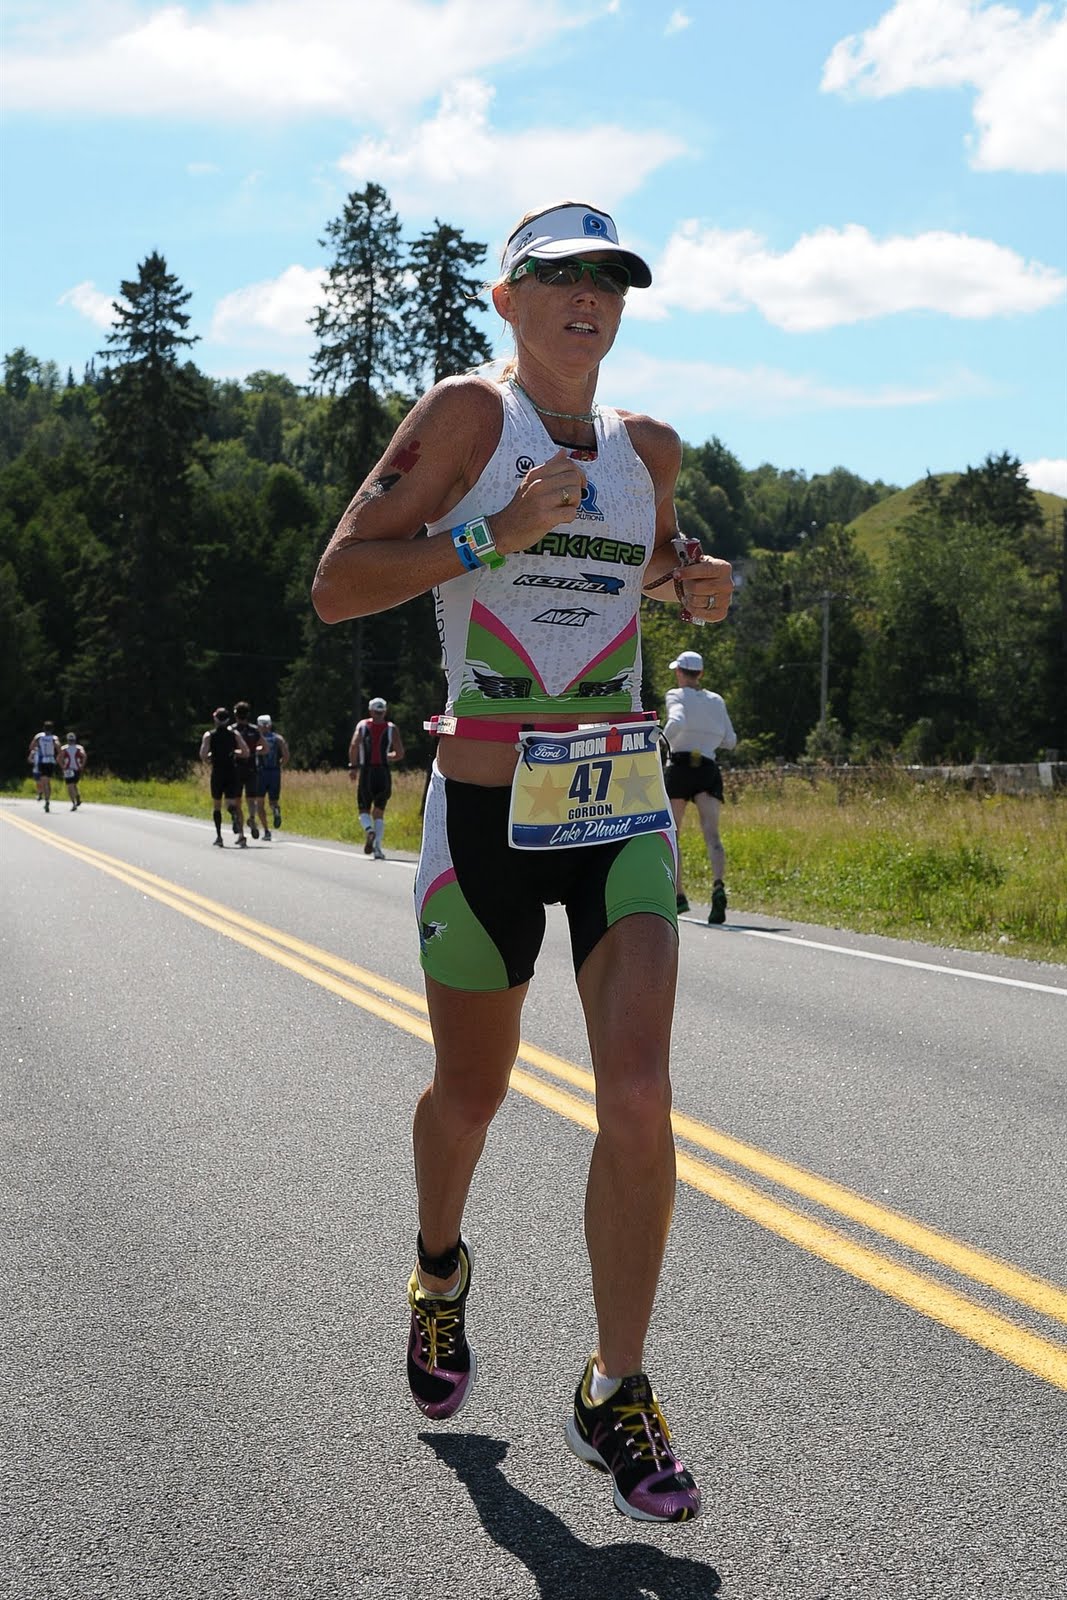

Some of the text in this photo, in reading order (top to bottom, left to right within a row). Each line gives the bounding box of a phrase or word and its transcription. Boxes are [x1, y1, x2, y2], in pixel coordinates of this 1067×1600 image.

[523, 532, 646, 566] AKKERS
[513, 574, 607, 594] KESTREL
[540, 608, 588, 626] AVIA
[534, 728, 647, 760] Ford IRONMAN
[568, 760, 613, 804] 47
[568, 804, 613, 820] GORDON
[550, 813, 657, 846] Lake Placid 2011
